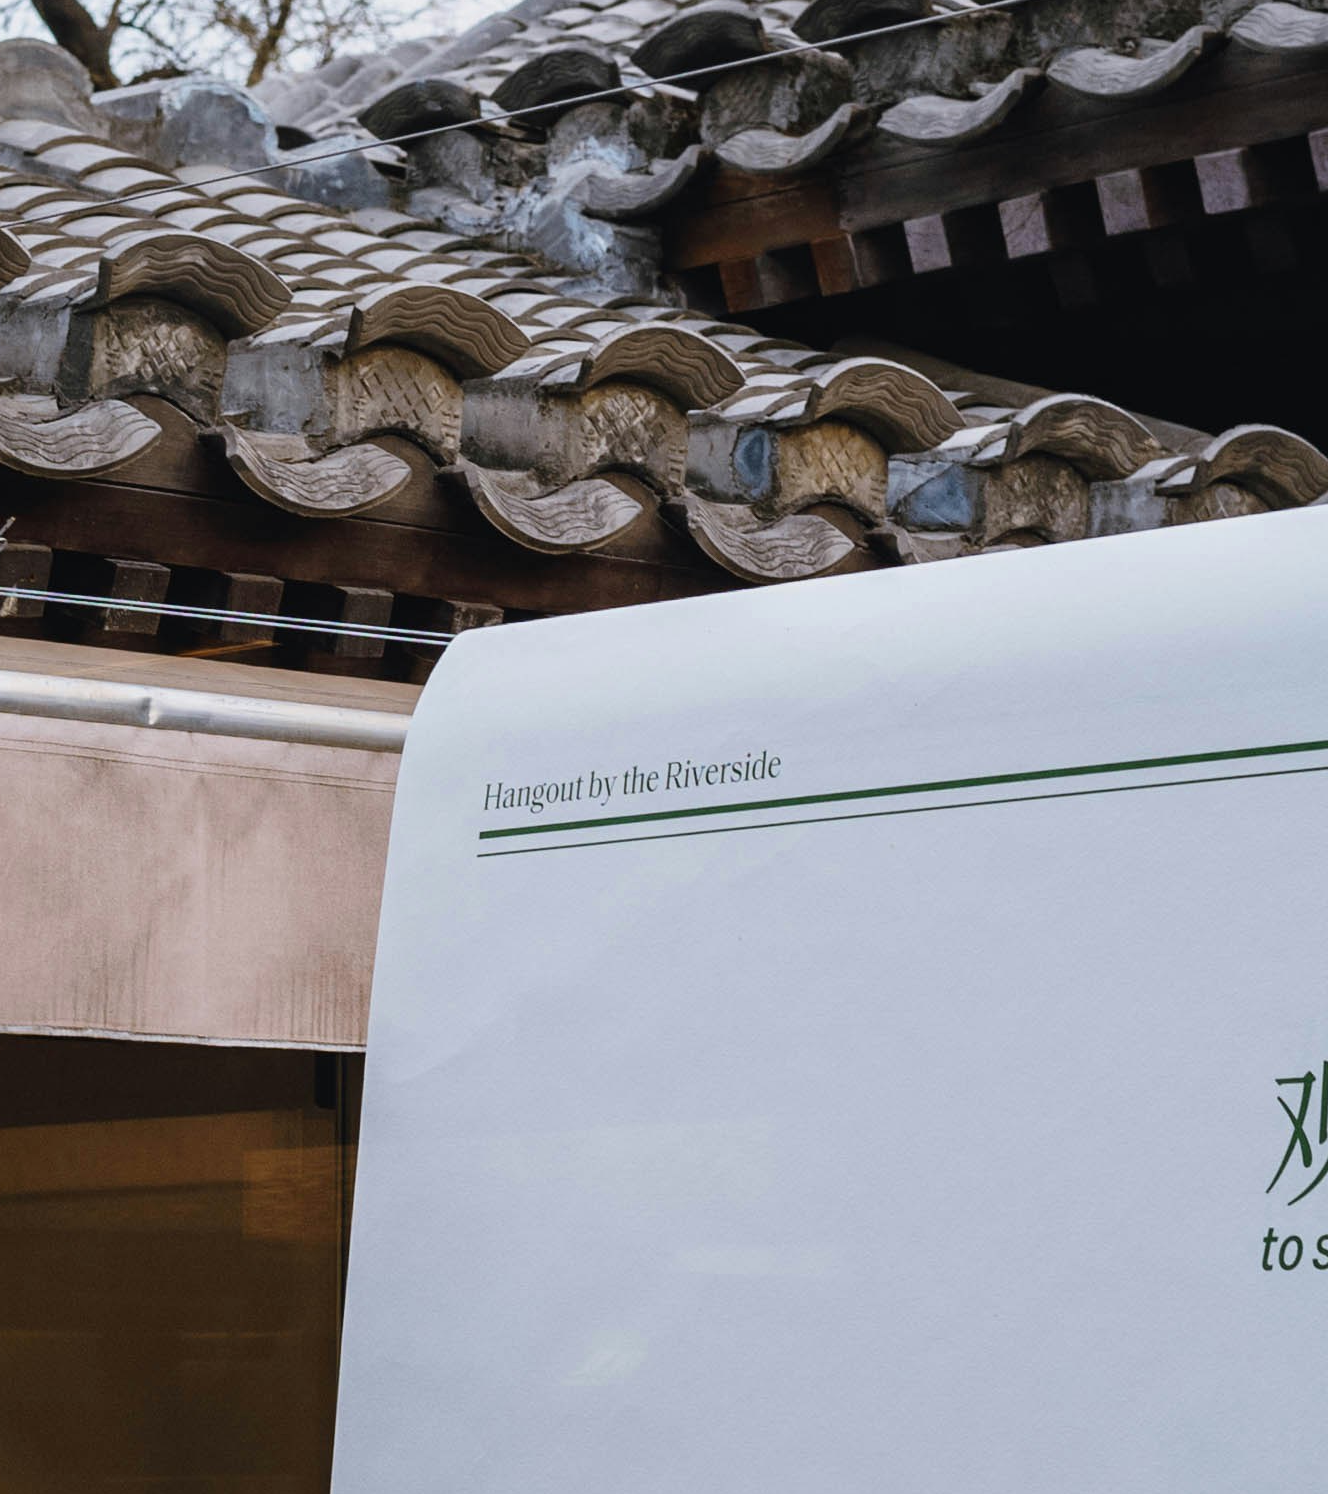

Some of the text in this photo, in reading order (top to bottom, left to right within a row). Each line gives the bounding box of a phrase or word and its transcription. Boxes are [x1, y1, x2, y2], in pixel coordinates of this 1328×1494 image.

[483, 750, 782, 815] Hangout by the Riverside
[1261, 1226, 1305, 1272] to
